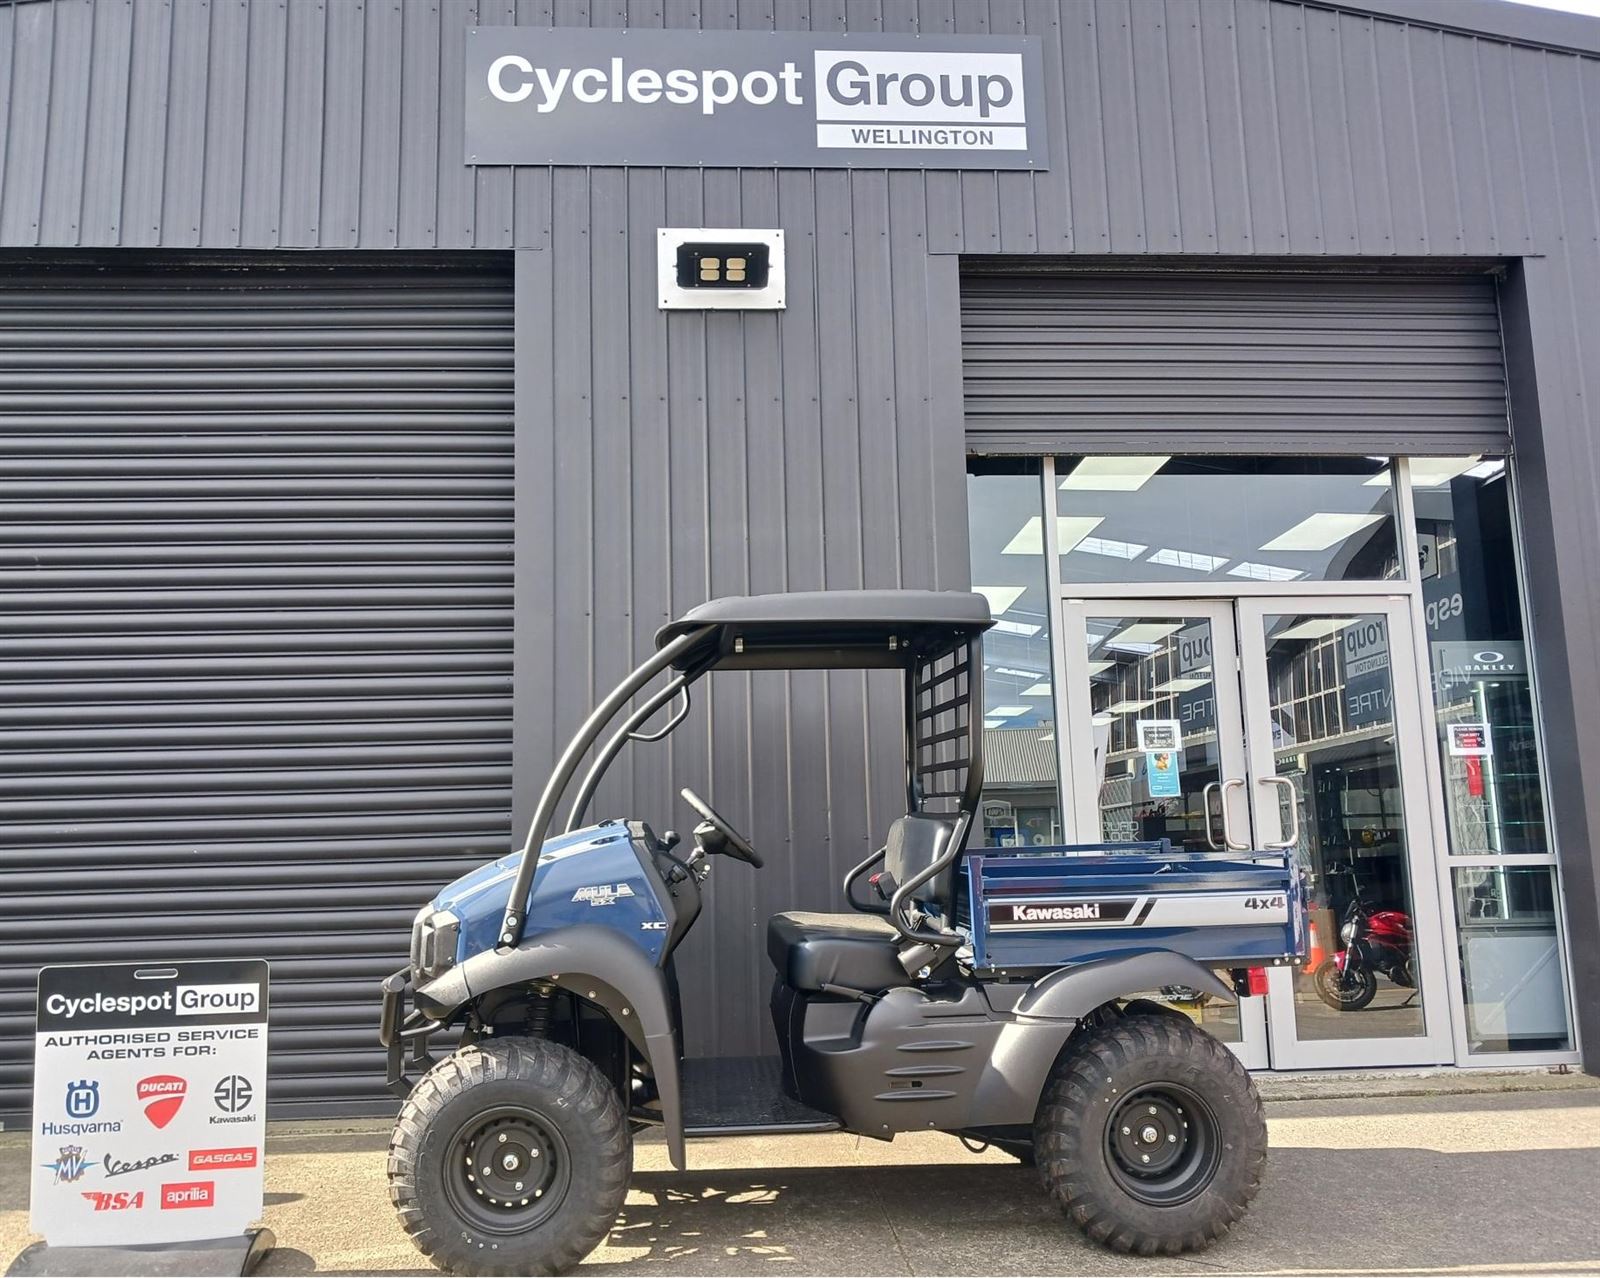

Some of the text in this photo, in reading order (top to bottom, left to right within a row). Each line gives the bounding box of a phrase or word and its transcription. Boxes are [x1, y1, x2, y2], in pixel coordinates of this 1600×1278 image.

[487, 55, 1013, 117] Cyclespot Group
[851, 128, 994, 146] WELLINGTON
[571, 883, 635, 902] MULE
[1013, 897, 1285, 921] Kawasaki 4x4
[641, 922, 667, 930] XC
[46, 989, 255, 1018] Cyclespot Group
[44, 1029, 259, 1047] AUTHORISED SERVICE
[87, 1045, 217, 1060] AGENTS FOR:
[140, 1081, 184, 1093] DUCATI
[209, 1114, 256, 1124] Kawasaki
[42, 1121, 121, 1136] Husqvarna
[104, 1153, 177, 1178] Vespa
[193, 1152, 253, 1164] GASGAS
[84, 1191, 144, 1211] BSA
[166, 1188, 209, 1203] aprilia
